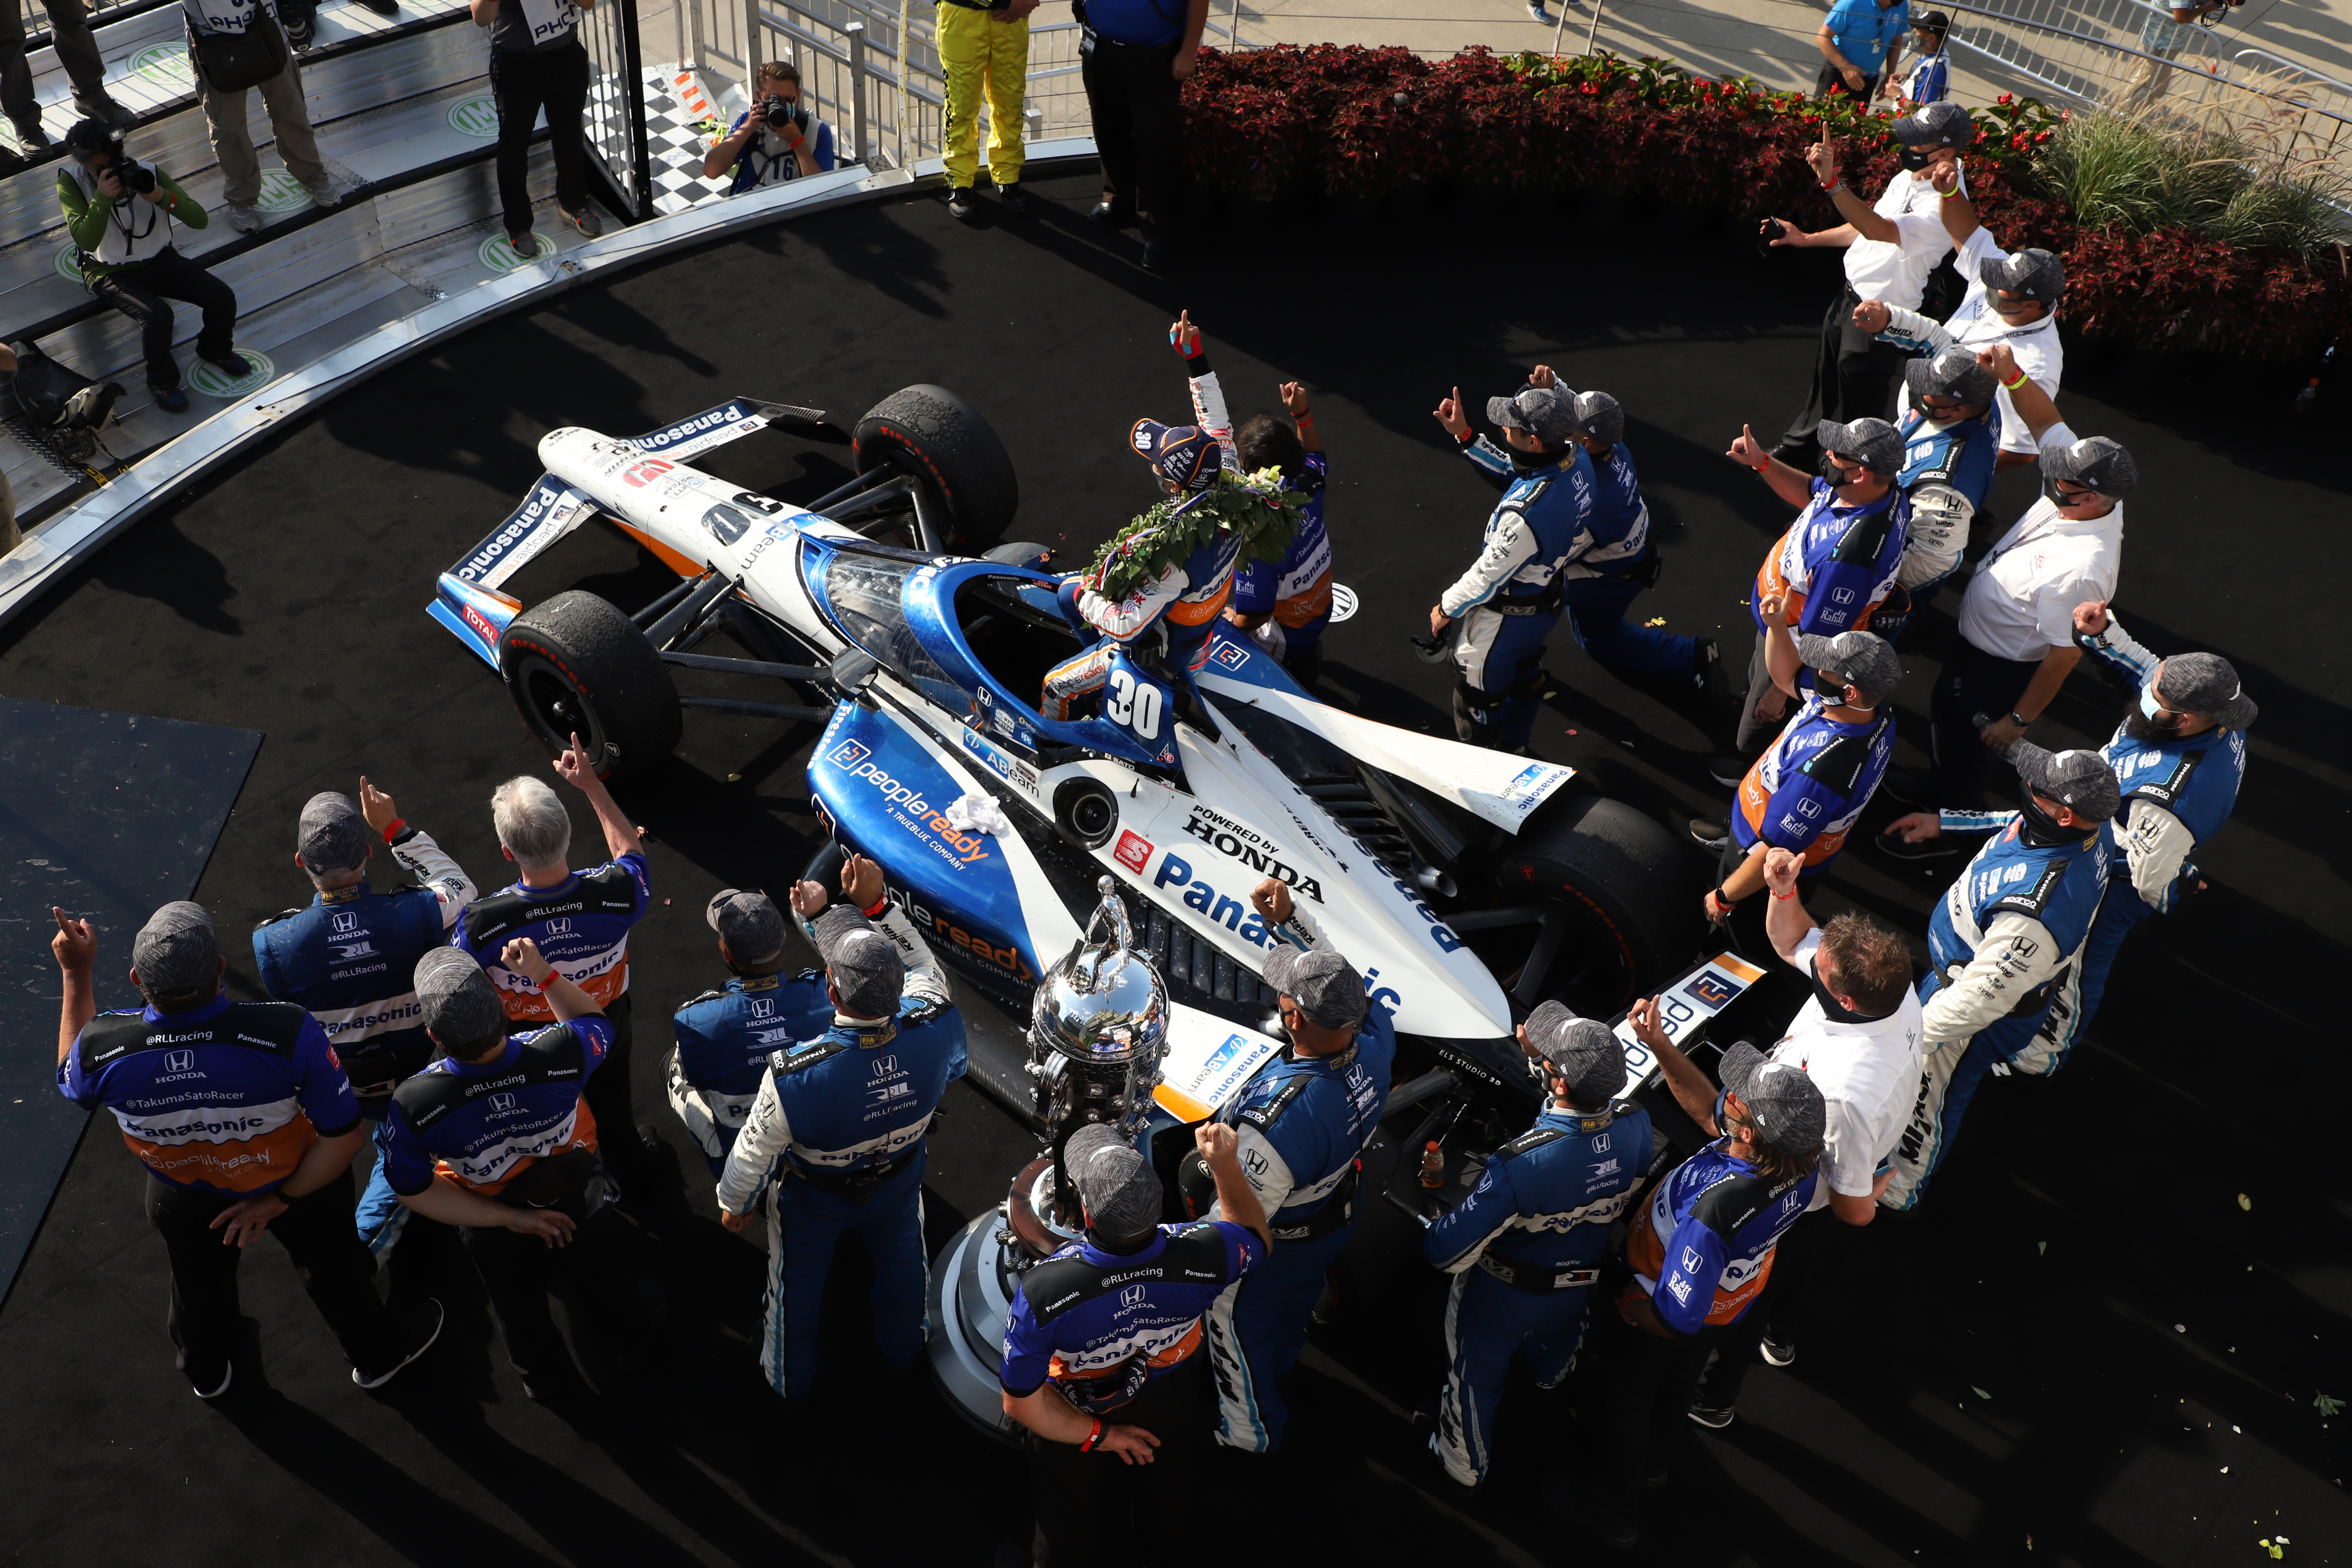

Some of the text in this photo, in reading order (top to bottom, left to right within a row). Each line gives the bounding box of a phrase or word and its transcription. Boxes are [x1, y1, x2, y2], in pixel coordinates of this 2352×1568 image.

[773, 158, 794, 181] 16
[265, 199, 291, 211] STAND
[220, 370, 271, 395] STAND HERE
[620, 405, 743, 451] Panasonic
[1135, 431, 1152, 450] 30
[1945, 446, 1958, 472] Firestone
[1617, 462, 1627, 482] HONDA
[1918, 471, 1947, 479] sparco
[1526, 481, 1546, 503] Firestone
[1574, 482, 1589, 501] HONDA
[459, 486, 558, 582] Panasonic
[1837, 518, 1861, 547] Firestone
[1872, 533, 1885, 559] Panasonic
[1236, 581, 1254, 595] Rahal
[466, 606, 495, 642] TOTAL
[1820, 609, 1847, 624] Rahal
[1055, 662, 1107, 694] peopleready
[1107, 669, 1163, 740] 30
[994, 717, 1014, 733] INDYCAR
[1867, 717, 1888, 749] @RLLracing
[807, 704, 853, 770] Firestone
[1021, 732, 1032, 746] PPG
[1812, 736, 1844, 762] Firestone
[1874, 745, 1889, 771] HONDA
[987, 751, 1040, 798] ABeam
[1113, 756, 1135, 771] SATO
[1498, 772, 1533, 801] ABeam
[1848, 762, 1862, 789] Panasonic
[2170, 763, 2191, 792] Firestone
[1519, 770, 1568, 811] Panasonic
[2138, 785, 2170, 800] sparco
[850, 763, 989, 862] peopleready
[1193, 805, 1280, 854] POWERED by
[1780, 815, 1808, 837] Rahal
[893, 810, 932, 843] TRUEBLUE
[929, 840, 966, 871] COMPANY
[1115, 851, 1141, 872] Speedway
[1182, 814, 1325, 904] HONDA
[322, 892, 334, 900] FIA
[2036, 871, 2056, 902] Firestone
[526, 901, 583, 919] @RLLracing
[2002, 896, 2037, 910] sparco
[327, 929, 371, 942] HONDA
[478, 922, 507, 941] Panasonic
[540, 933, 582, 945] HONDA
[916, 924, 1035, 990] TRUEBLUE COMPANY
[2009, 960, 2029, 973] Rentals
[2011, 957, 2030, 969] United
[331, 962, 387, 980] @RLLRacing
[1995, 962, 2015, 977] Luther
[746, 1015, 786, 1027] HONDA
[146, 1030, 213, 1046] @RLLracing
[237, 1033, 277, 1049] Panasonic
[862, 1037, 875, 1045] FIA
[95, 1045, 125, 1063] Panasonic
[788, 1047, 827, 1068] Firestone
[155, 1071, 208, 1084] HONDA
[548, 1068, 578, 1077] Panasonic
[1188, 1050, 1228, 1092] ABeam
[1209, 1044, 1271, 1103] Panasonic
[1438, 1049, 1501, 1086] ELS STUDIO 3D
[465, 1074, 526, 1096] @RLLracing
[867, 1070, 910, 1088] HONDA
[1346, 1076, 1373, 1102] HONDA
[126, 1091, 245, 1109] @TakumaSatoRacer
[864, 1099, 917, 1121] @RLLRacing
[1267, 1086, 1295, 1118] Firestone
[416, 1104, 446, 1126] Panasonic
[485, 1107, 530, 1122] HONDA
[127, 1117, 265, 1139] Panasonic
[465, 1111, 564, 1152] @TakumaSatoRacer
[462, 1119, 573, 1177] Panasonic
[1517, 1131, 1554, 1148] Firestone
[166, 1148, 271, 1171] peopleready
[1246, 1172, 1264, 1187] United
[1586, 1178, 1619, 1194] @RLLRacing
[1775, 1202, 1802, 1227] HONDA
[1101, 1266, 1164, 1288] @RLLracing
[1185, 1269, 1217, 1278] Panasonic
[1668, 1273, 1692, 1303] Rahal
[1046, 1290, 1080, 1313] Panasonic
[1113, 1302, 1157, 1320] HONDA
[1677, 1297, 1687, 1308] Group
[1086, 1315, 1188, 1349] @TakumaSatoRacer
